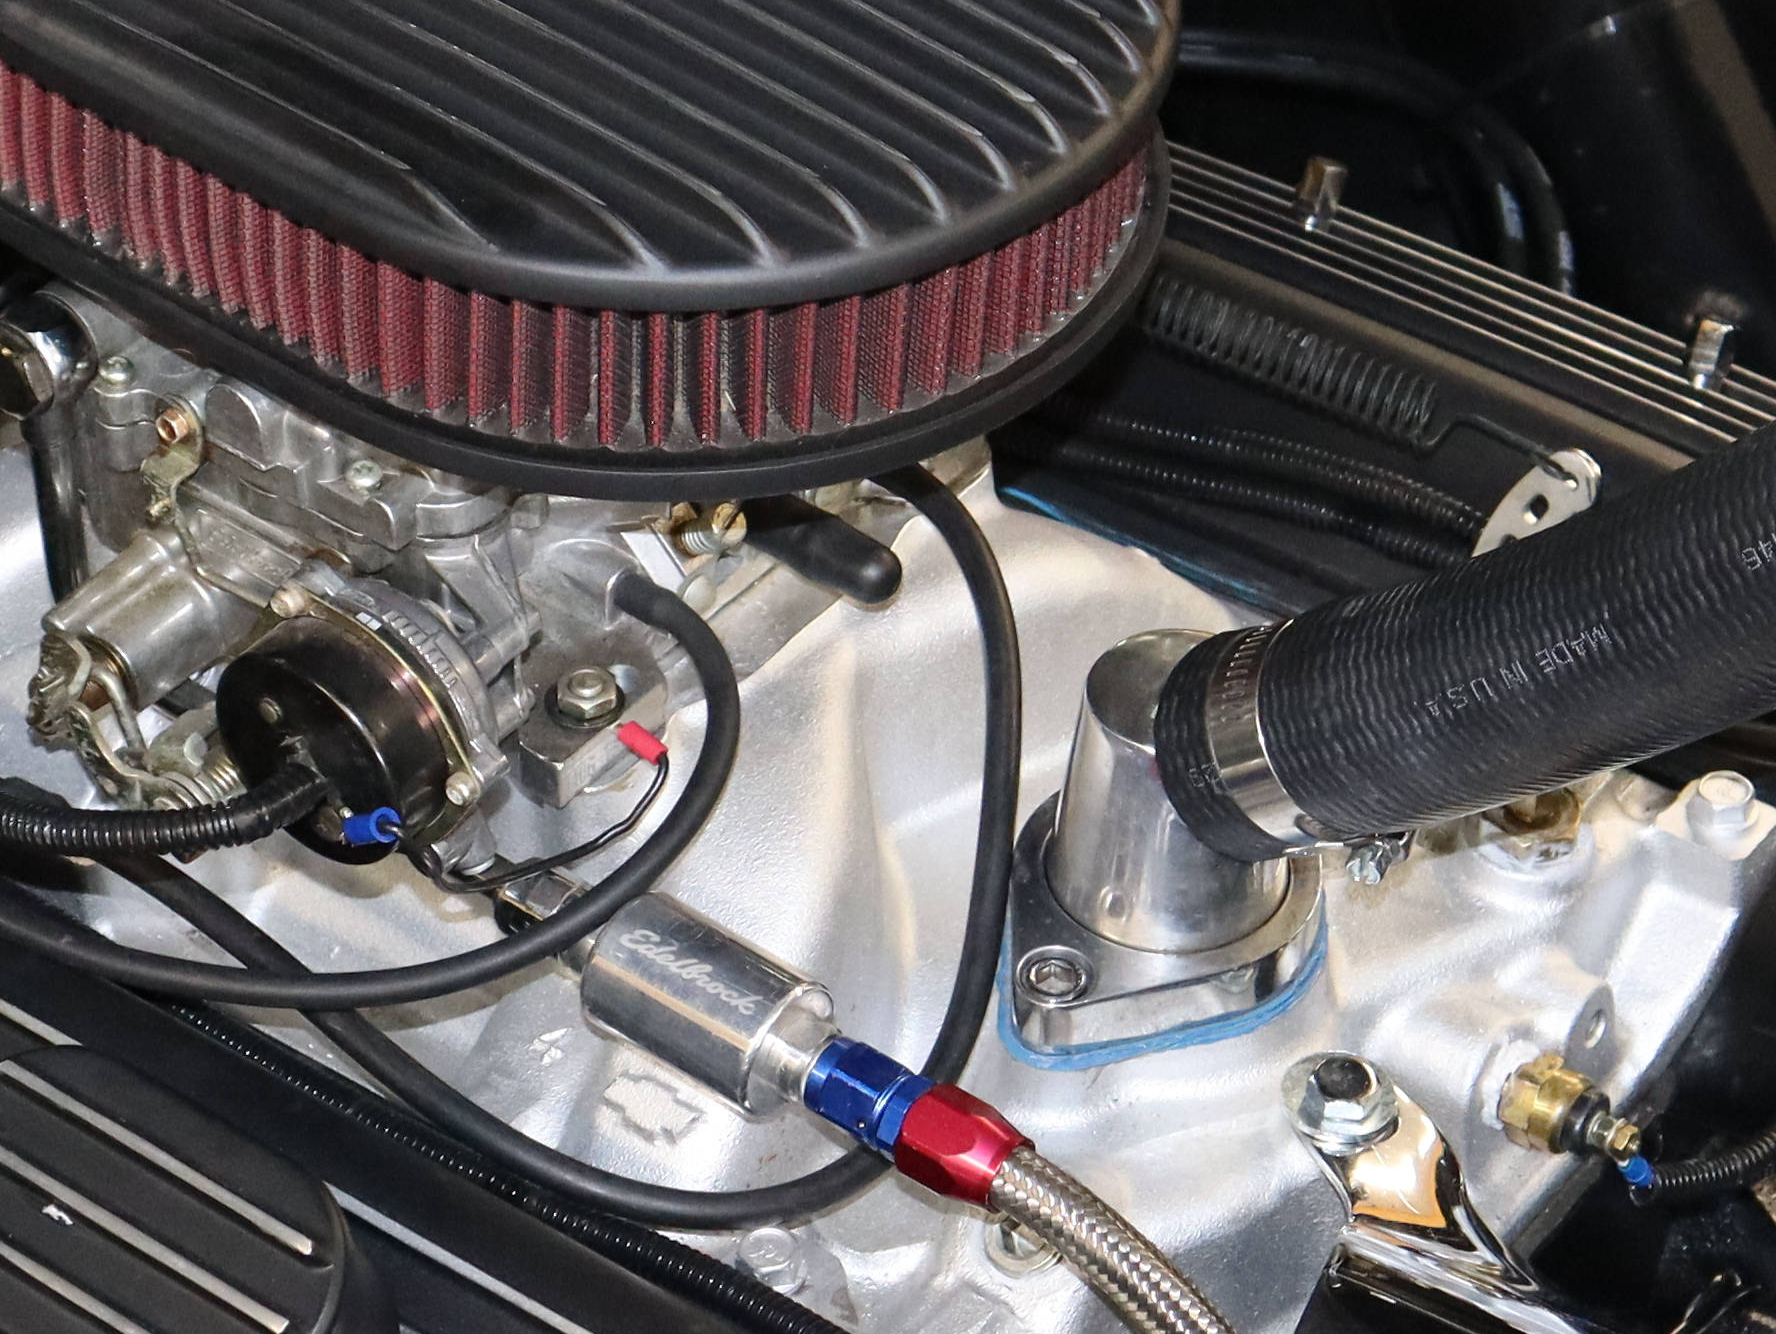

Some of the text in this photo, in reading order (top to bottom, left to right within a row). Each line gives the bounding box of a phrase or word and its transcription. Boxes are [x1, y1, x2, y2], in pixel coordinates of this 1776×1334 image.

[1497, 649, 1534, 695] IN
[1540, 618, 1617, 680] MADE
[619, 929, 764, 1016] Edelbrock
